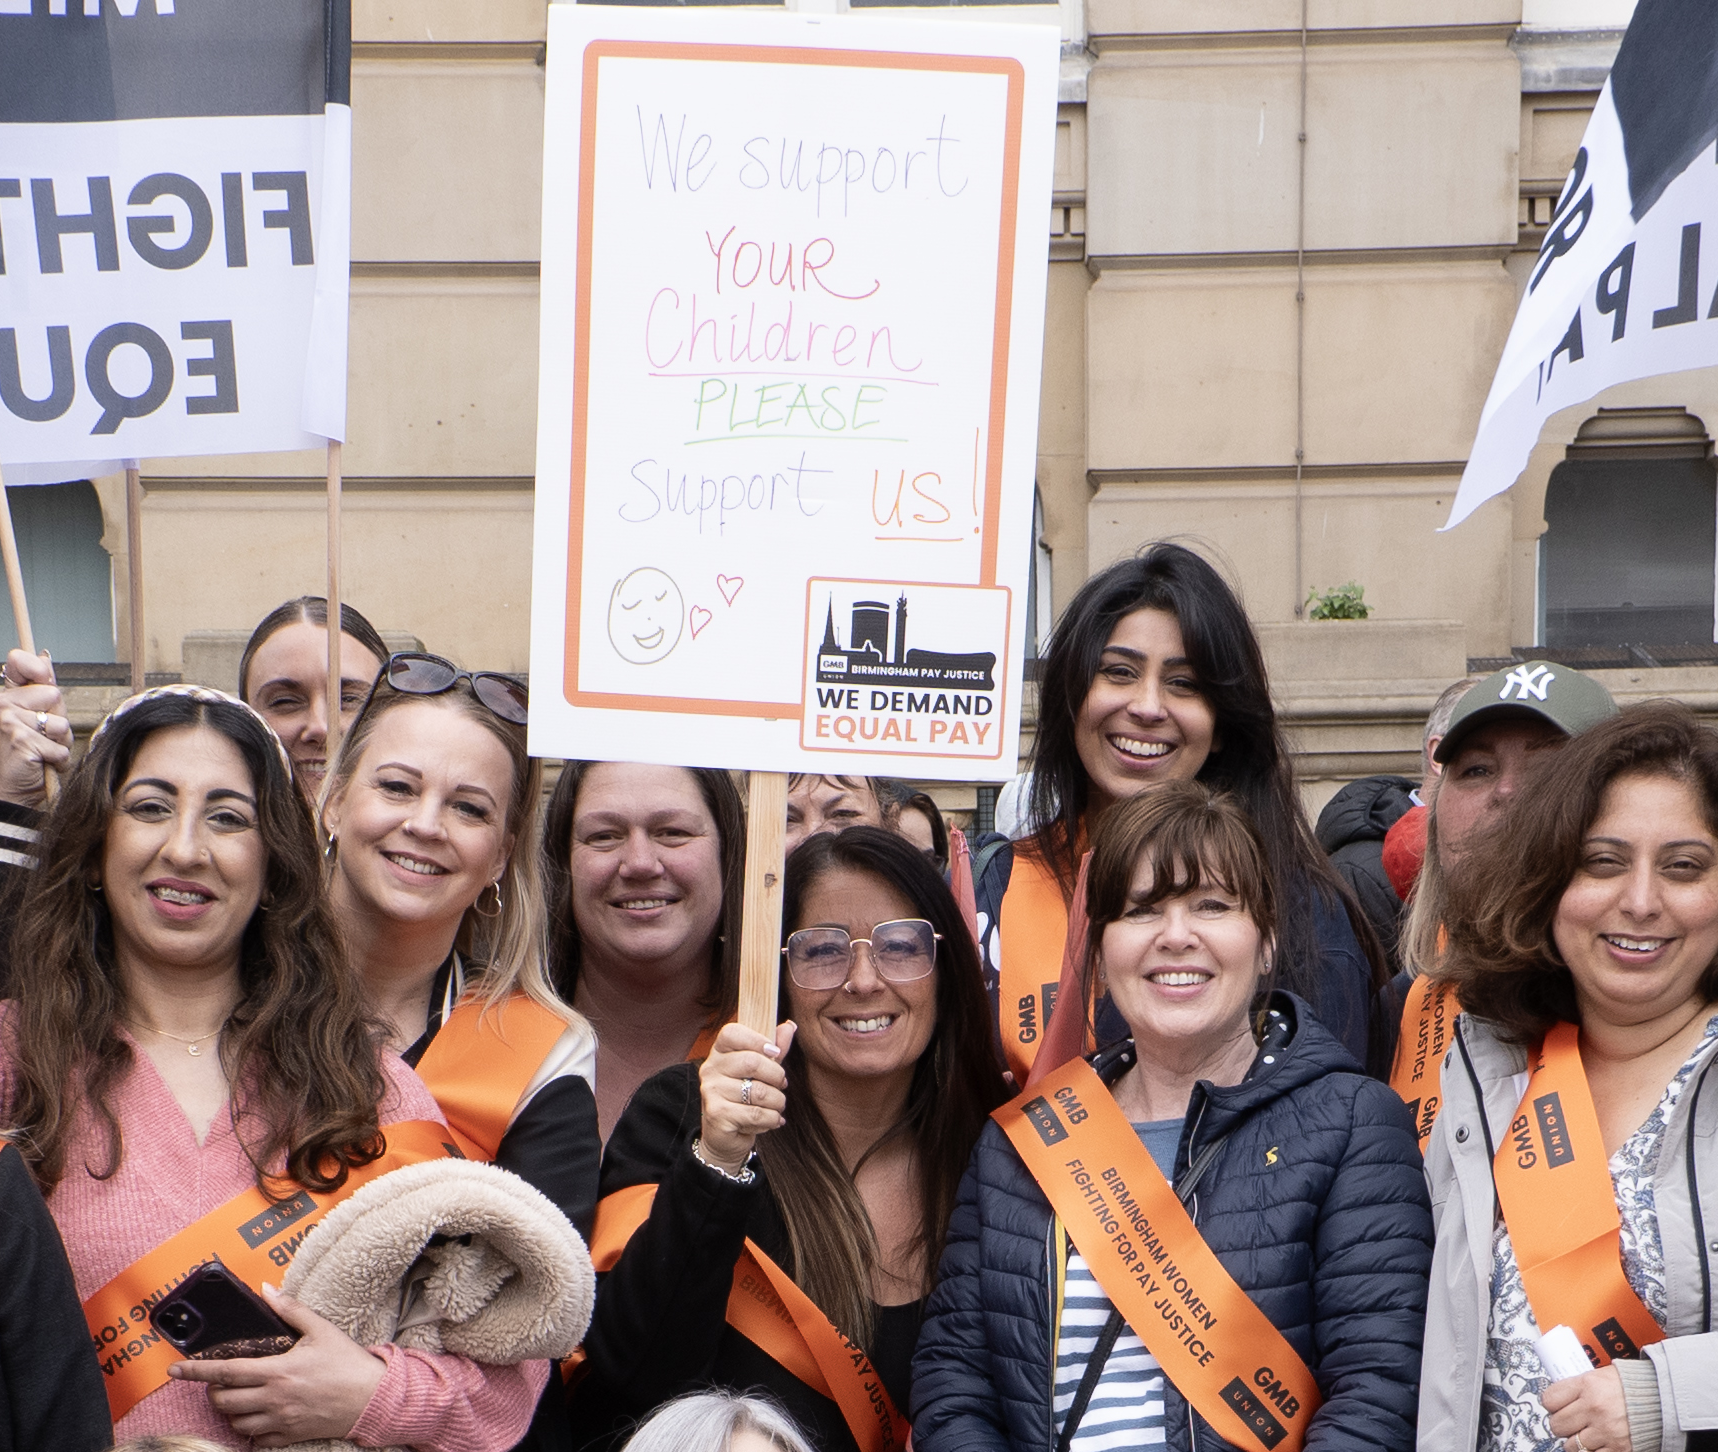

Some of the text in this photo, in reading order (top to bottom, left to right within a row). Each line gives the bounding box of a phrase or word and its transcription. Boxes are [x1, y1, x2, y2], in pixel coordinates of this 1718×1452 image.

[636, 103, 969, 218] We support
[705, 225, 880, 299] YOUR
[645, 287, 924, 372] Children
[694, 378, 888, 432] PLEASE
[823, 660, 845, 668] GMB
[851, 664, 985, 681] BIRMINGHAM PAY JUSTICE
[816, 687, 993, 716] WE DEMAND
[815, 714, 992, 745] EQUAL PAY
[1019, 993, 1037, 1044] GMB
[1411, 1018, 1429, 1083] JUSTICE
[1030, 1103, 1057, 1137] UNION
[1054, 1087, 1089, 1125] GMB
[1543, 1103, 1564, 1156] UNION
[1512, 1115, 1537, 1169] GMB
[252, 1201, 304, 1237] UNION
[1066, 1158, 1214, 1367] FIGHTING FOR PAY JUSTICE
[1101, 1167, 1217, 1331] BIRMINGHAM WOMEN
[864, 1382, 894, 1447] JUSTICE
[1233, 1390, 1274, 1436] UNION
[1253, 1367, 1300, 1419] GMB
